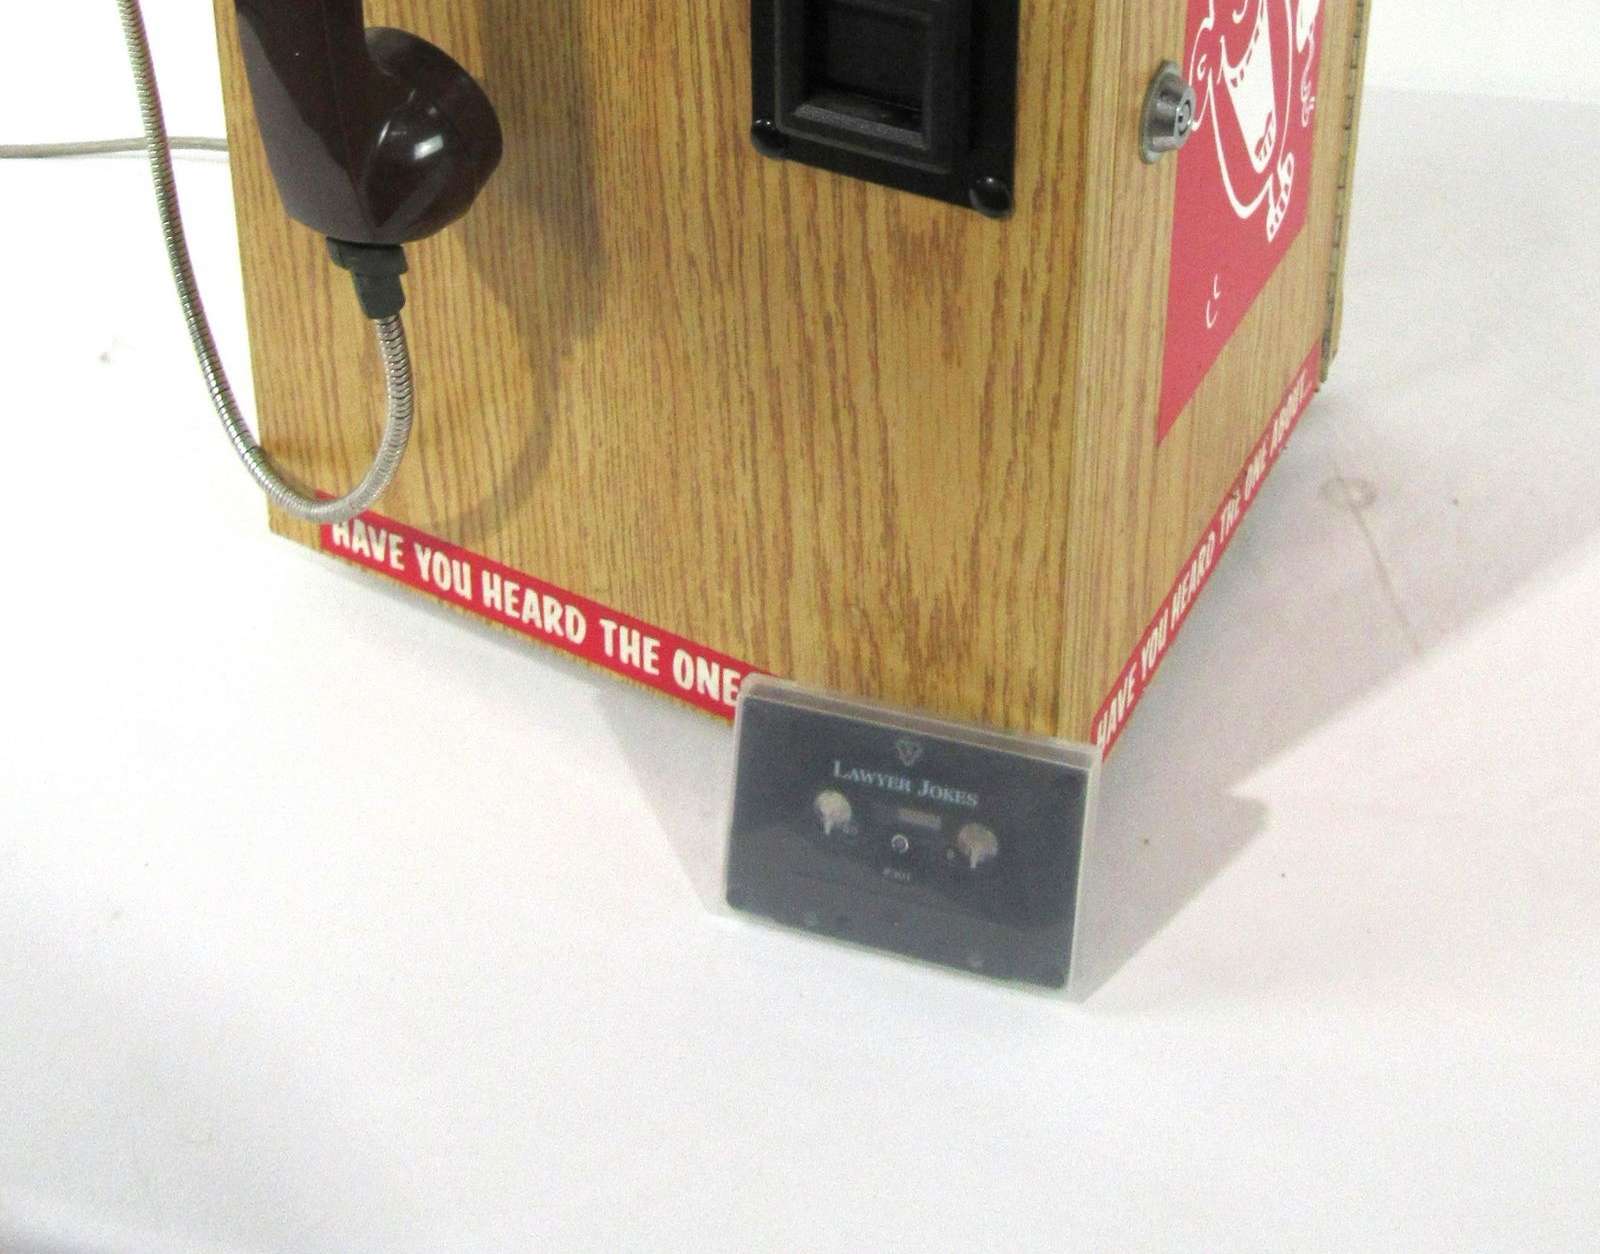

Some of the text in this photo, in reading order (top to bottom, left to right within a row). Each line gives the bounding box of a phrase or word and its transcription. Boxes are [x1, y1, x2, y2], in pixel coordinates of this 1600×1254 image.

[331, 518, 742, 707] HAVE YOU HEARD THE ONE
[1096, 660, 1138, 747] HAVE
[1141, 607, 1169, 679] YOU
[1170, 530, 1216, 630] HEARD
[1220, 487, 1241, 544] THE
